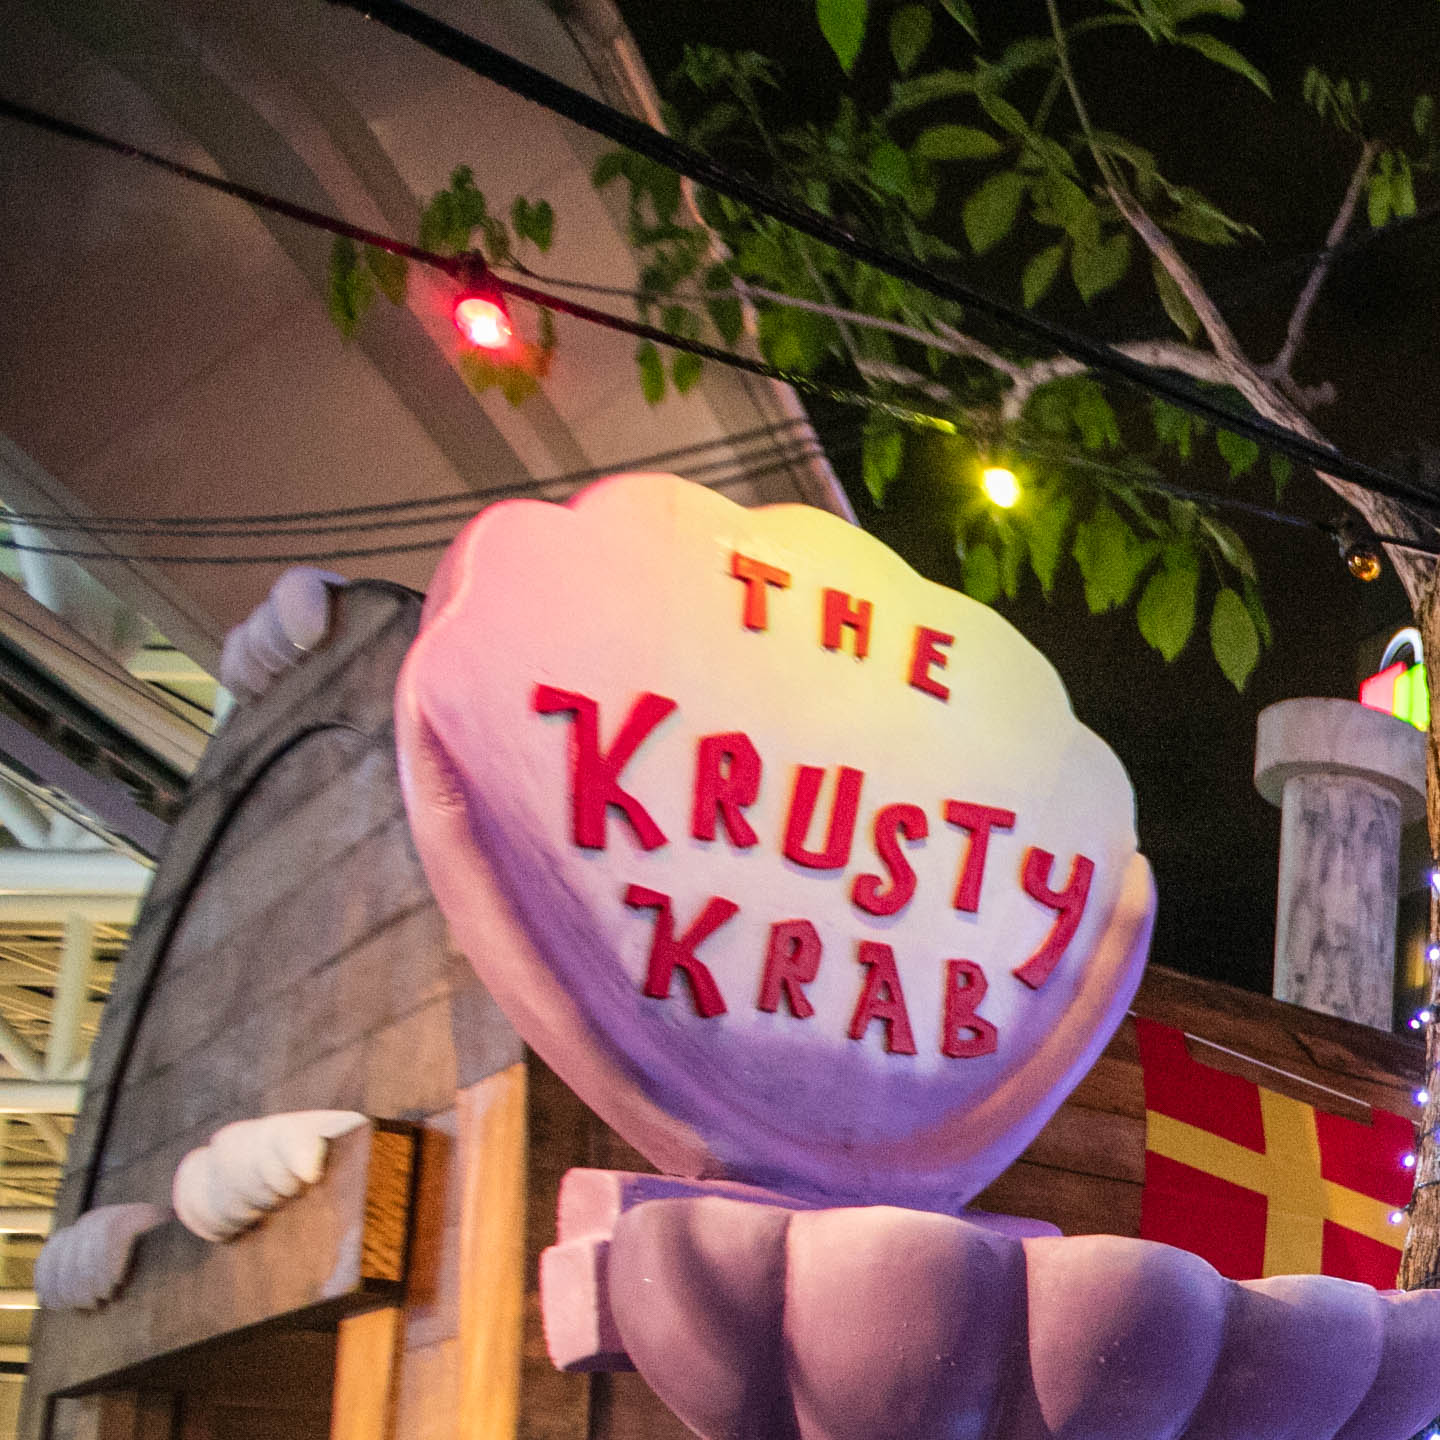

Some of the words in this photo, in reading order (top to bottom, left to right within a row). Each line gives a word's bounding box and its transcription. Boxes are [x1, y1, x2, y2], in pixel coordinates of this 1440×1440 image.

[729, 549, 957, 703] THE
[531, 682, 1096, 990] KRUSTY
[623, 883, 998, 1059] KRAB
